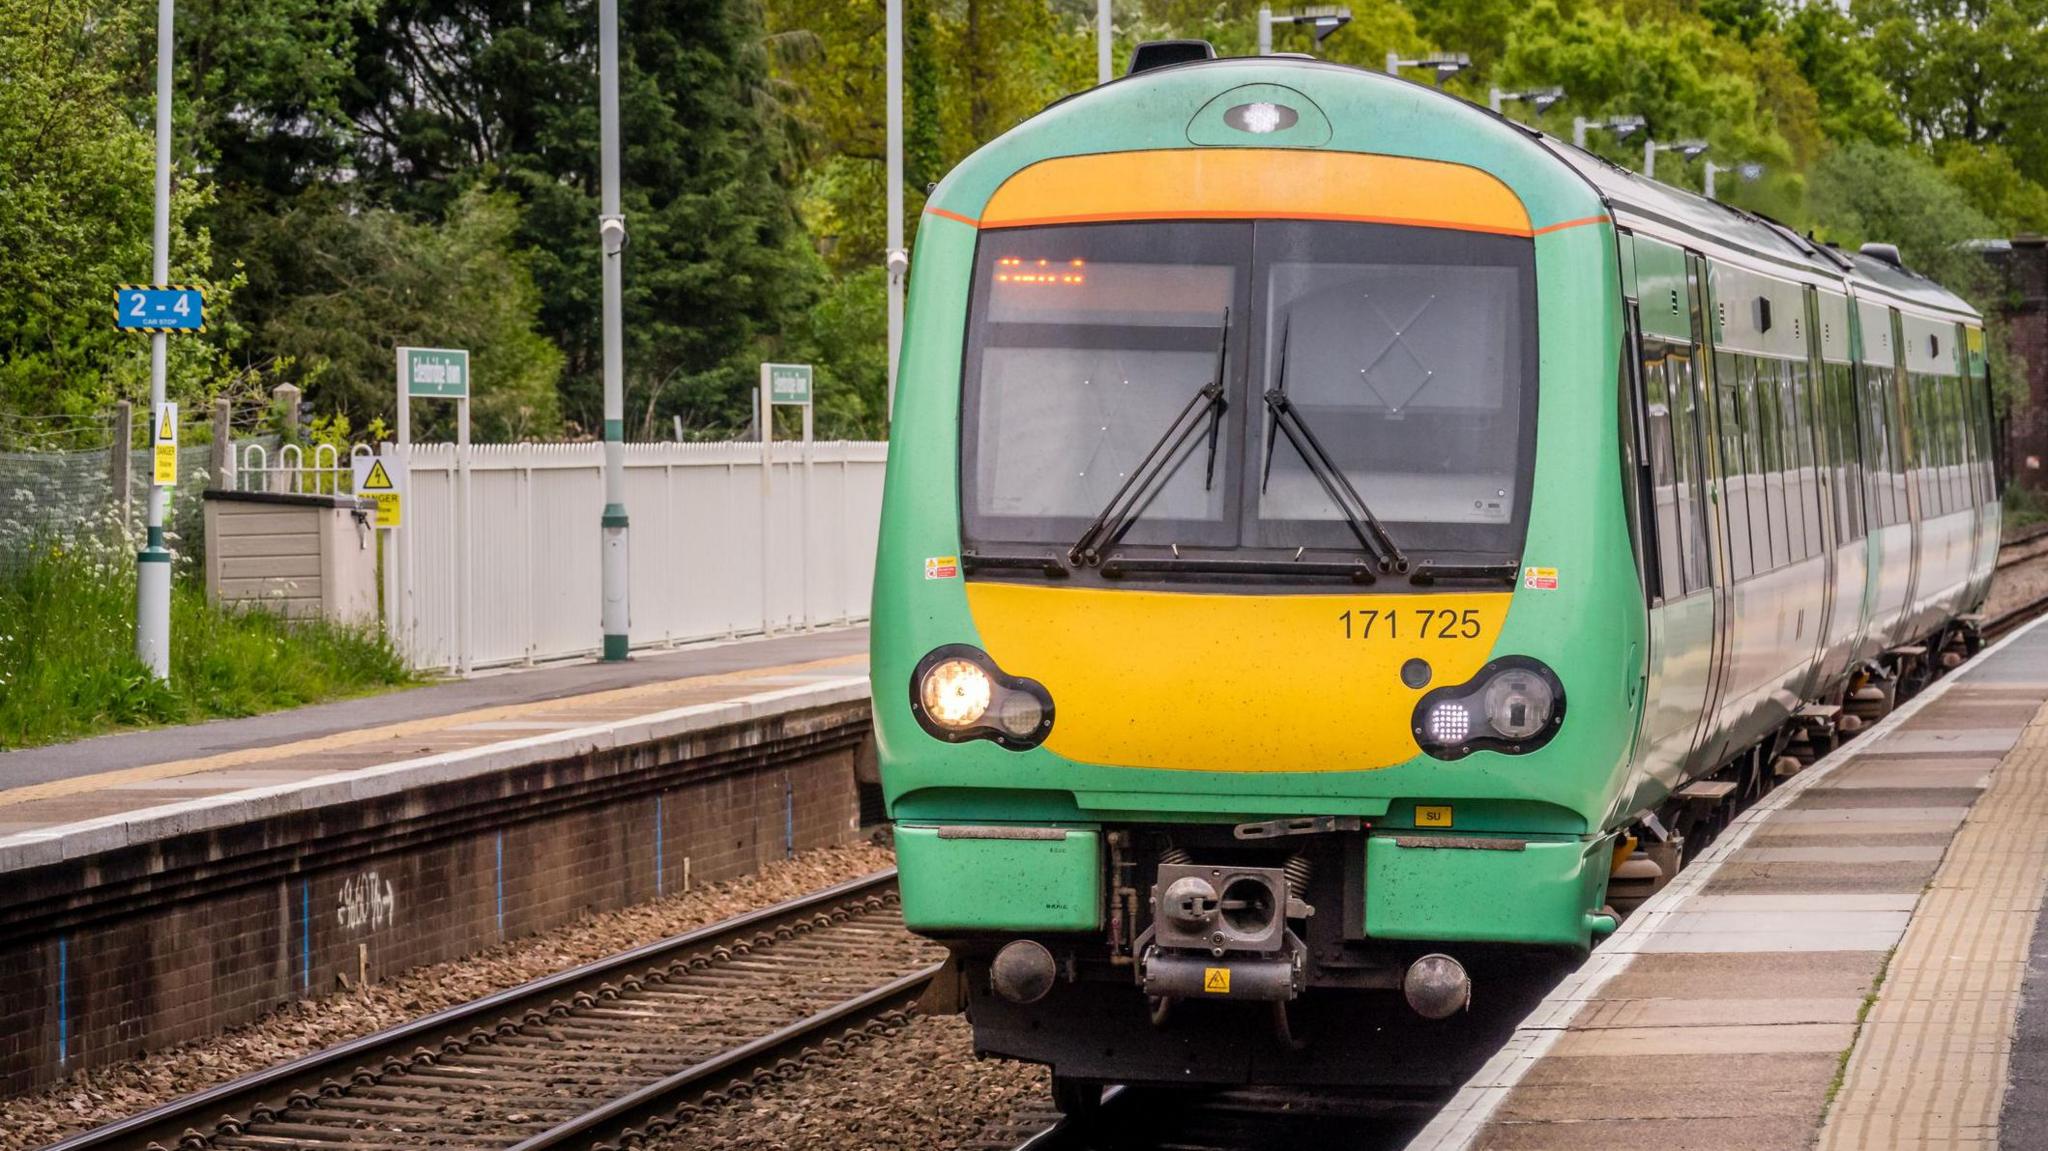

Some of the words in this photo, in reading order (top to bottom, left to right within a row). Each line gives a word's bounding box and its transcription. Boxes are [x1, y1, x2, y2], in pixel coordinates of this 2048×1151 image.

[130, 293, 146, 316] 2
[173, 293, 190, 317] 4
[1339, 609, 1396, 639] 171
[1415, 609, 1481, 639] 725
[1426, 811, 1441, 821] SU
